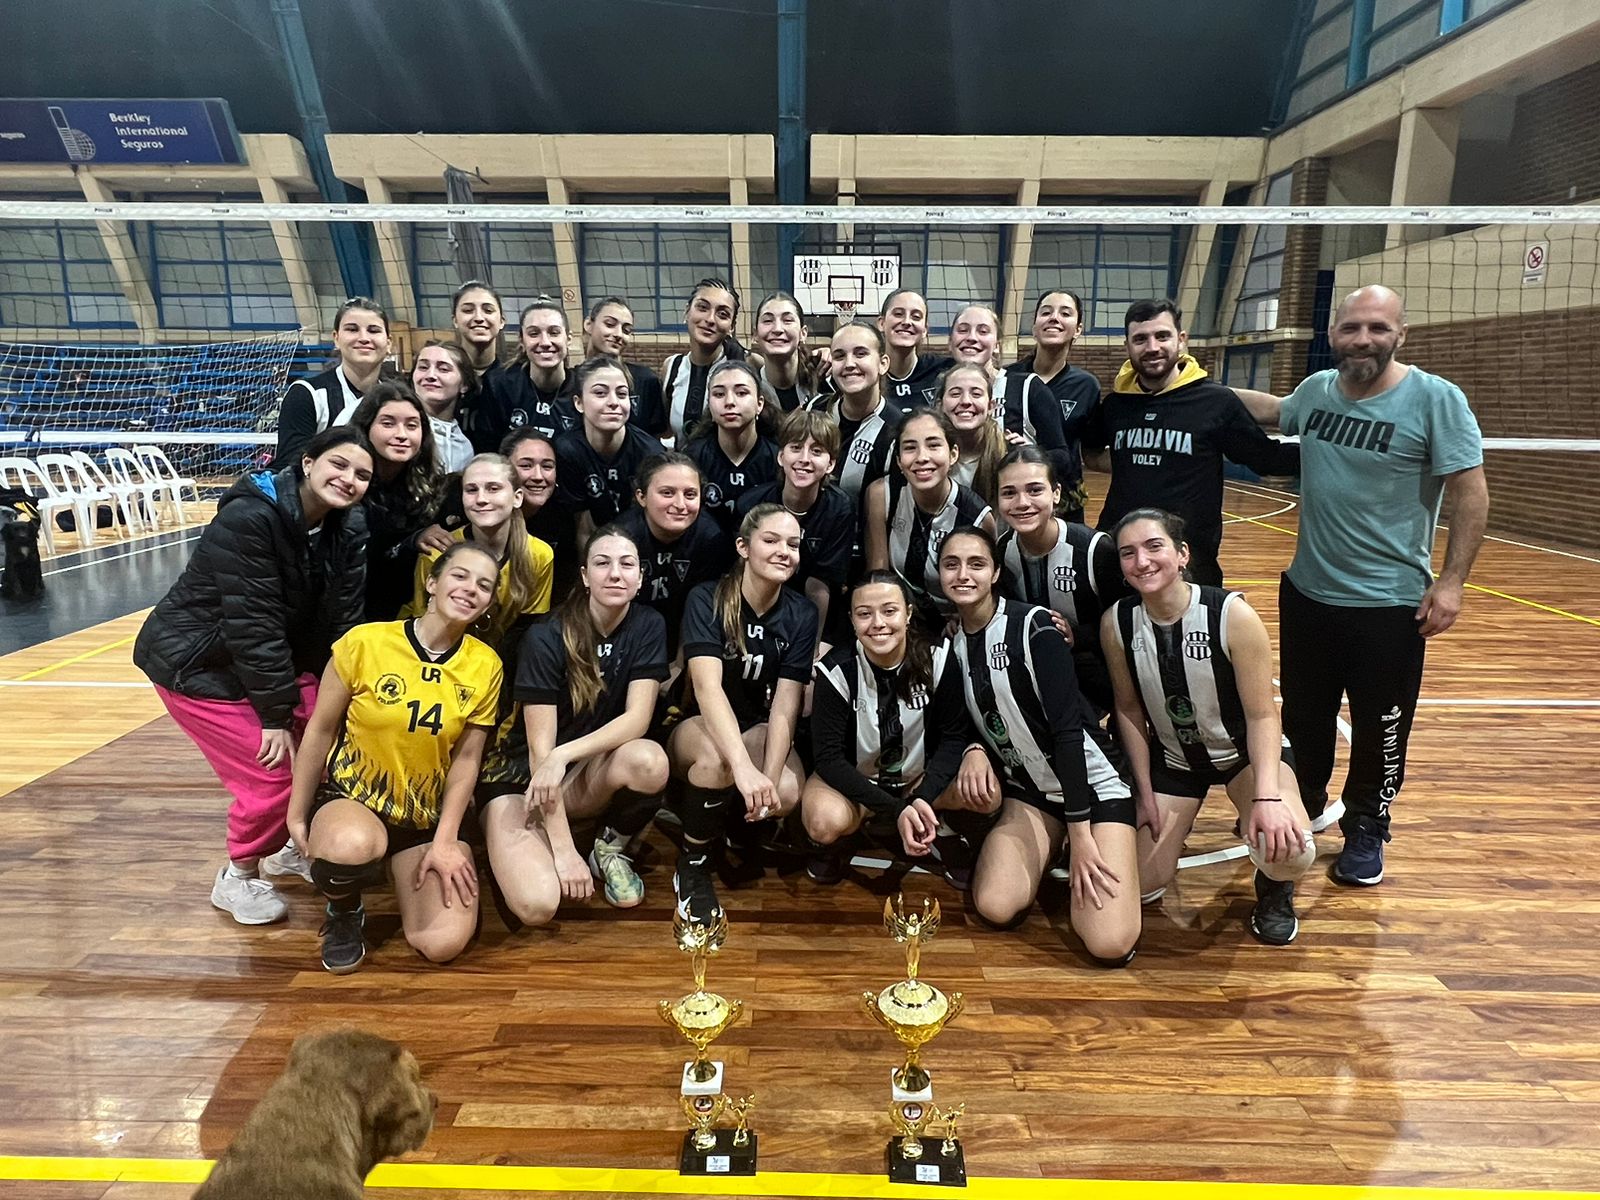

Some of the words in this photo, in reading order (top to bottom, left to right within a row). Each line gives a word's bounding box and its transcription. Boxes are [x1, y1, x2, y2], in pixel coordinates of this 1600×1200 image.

[109, 112, 151, 125] Berkley
[115, 126, 188, 136] International
[121, 139, 164, 151] Seguros
[896, 384, 911, 396] UR
[536, 401, 550, 415] UR
[1303, 408, 1395, 454] PUMA
[1132, 453, 1162, 466] VOLEY
[729, 472, 745, 486] UR
[747, 623, 764, 640] UR
[597, 643, 613, 658] UR
[741, 653, 764, 680] 11
[421, 666, 442, 684] UR
[406, 699, 443, 736] 14
